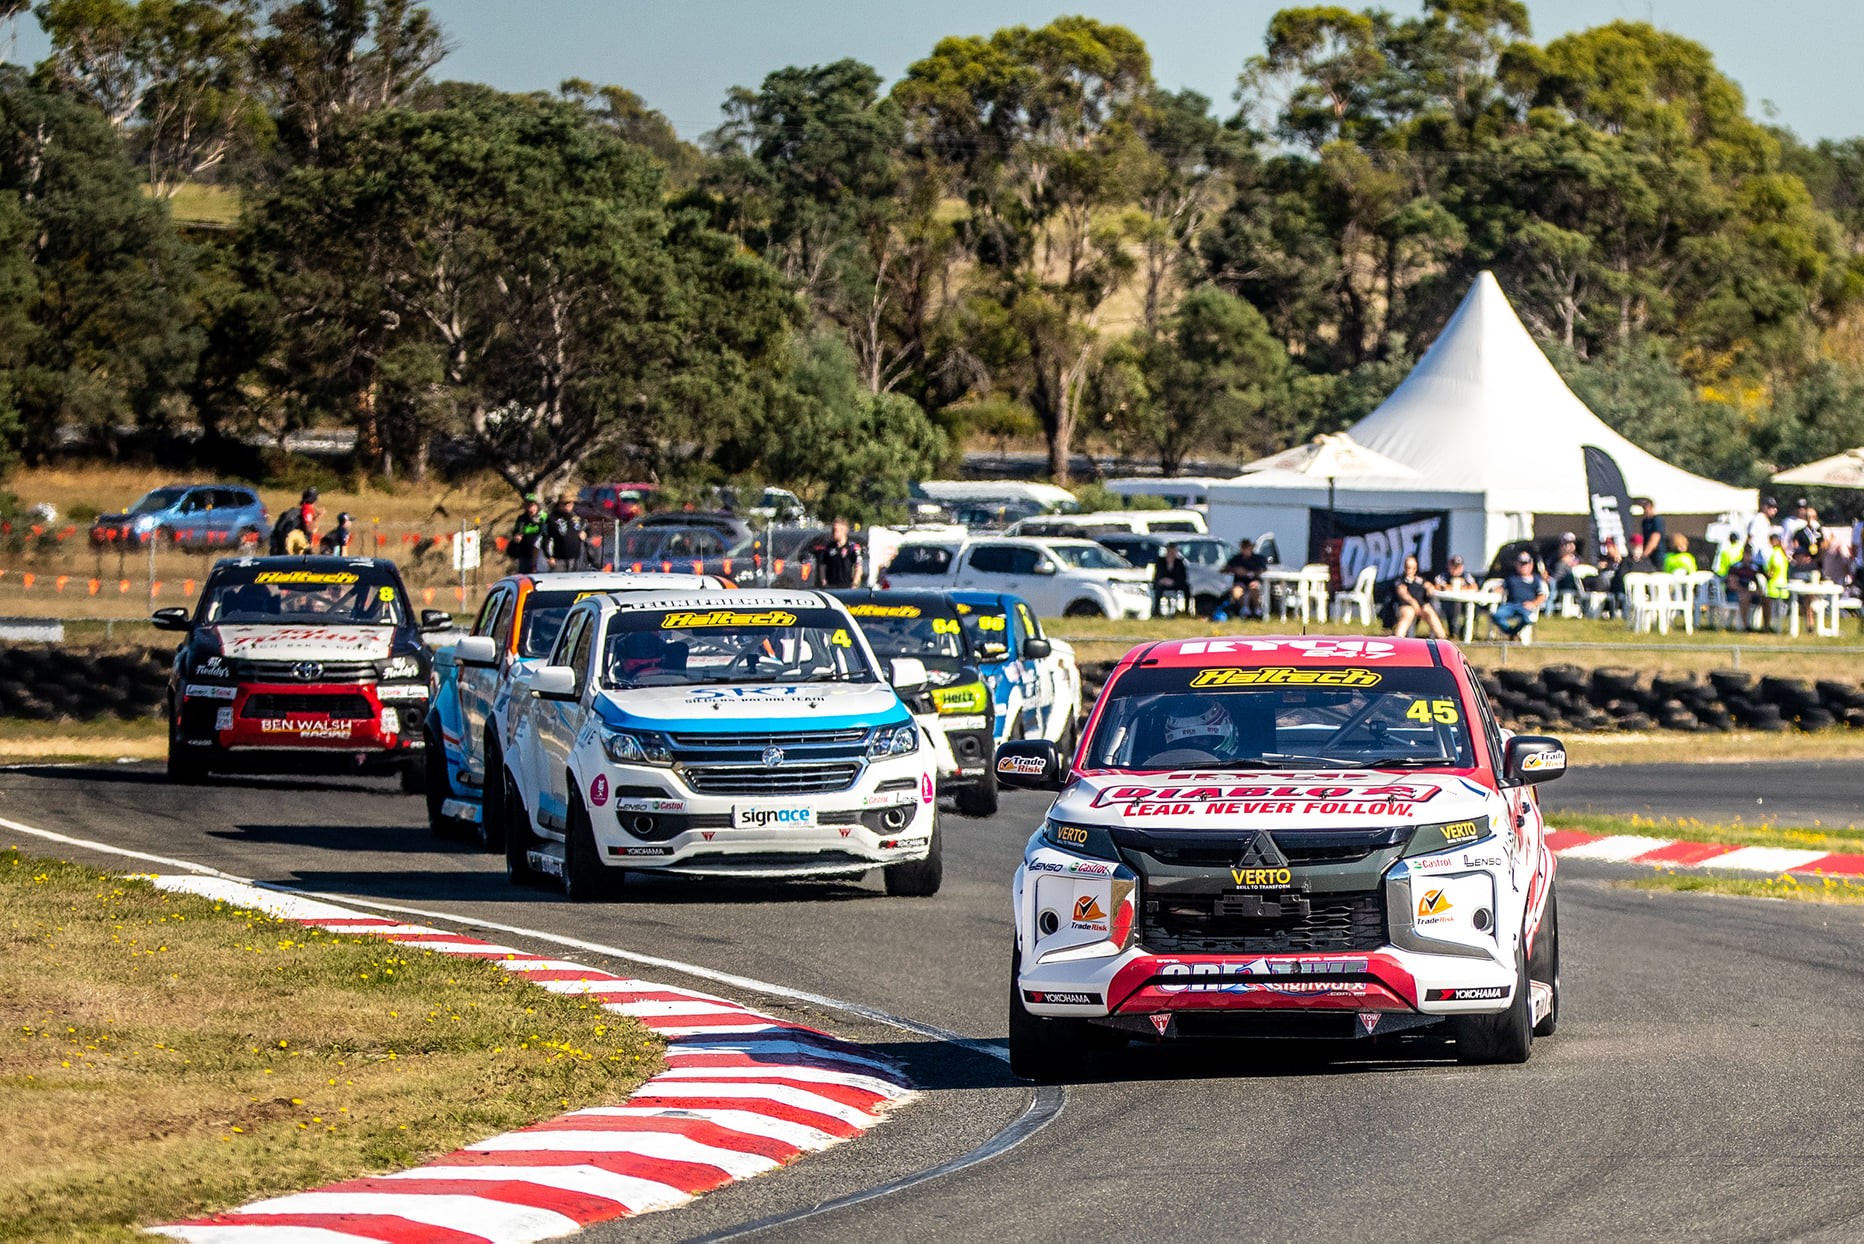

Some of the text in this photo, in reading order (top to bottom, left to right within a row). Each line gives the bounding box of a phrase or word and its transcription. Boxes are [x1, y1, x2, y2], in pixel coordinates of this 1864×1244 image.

[1340, 517, 1441, 589] DRIFT
[379, 586, 394, 602] 8
[661, 611, 797, 628] Haltech
[932, 618, 960, 634] 64
[831, 629, 852, 648] 4
[1179, 640, 1394, 655] RYCO
[1191, 667, 1382, 688] Haltech
[1406, 700, 1459, 724] 45
[261, 720, 352, 730] BEN WALSH
[1014, 756, 1045, 766] Trade
[1017, 765, 1042, 773] Risk
[1112, 787, 1353, 798] DIABLO
[660, 801, 684, 811] Castrol
[1124, 803, 1414, 817] LEAD. NEVER FOLLOW.
[741, 807, 810, 826] signace
[1057, 826, 1089, 843] VERTO
[1440, 821, 1477, 839] VERTO
[627, 848, 665, 856] YOKOHAMA
[1028, 857, 1108, 874] LENSO Castrol
[1422, 855, 1502, 868] Castrol LENSO
[1232, 868, 1291, 885] VERTO
[1044, 993, 1091, 1004] YOKOHAMA
[1455, 989, 1501, 999] YOKOHAMA
